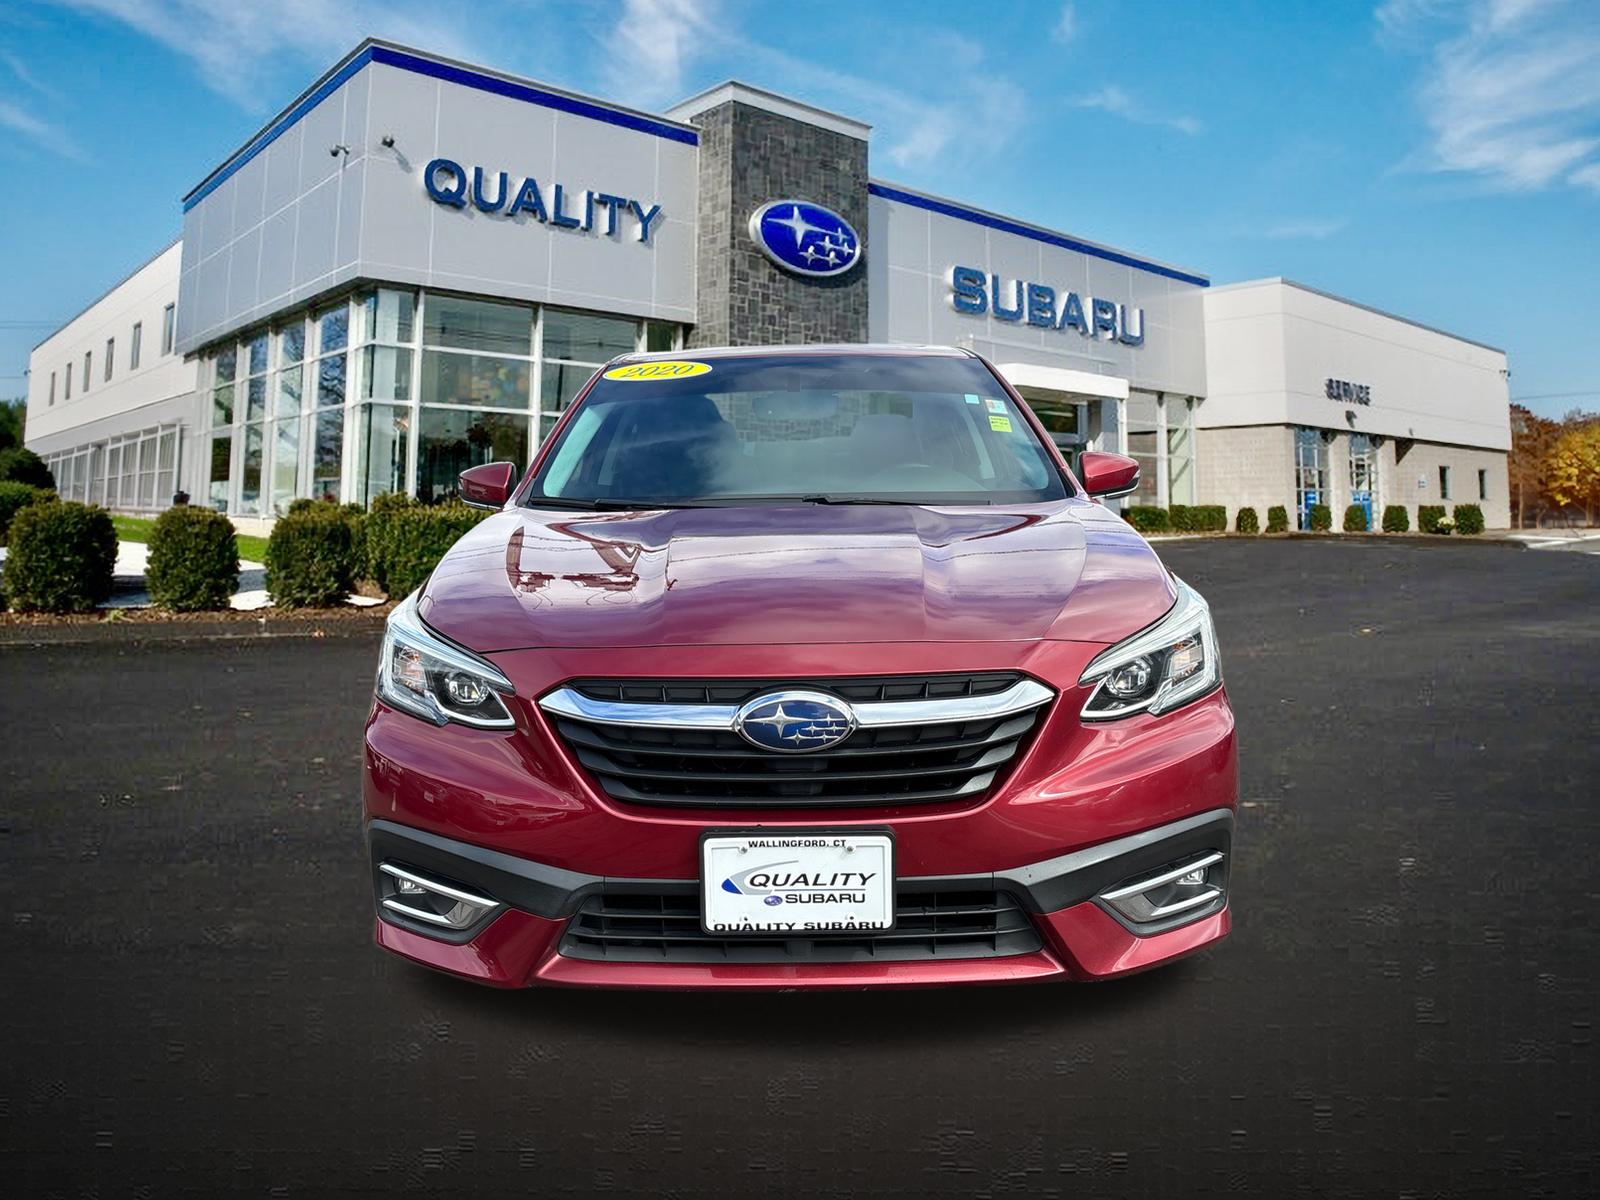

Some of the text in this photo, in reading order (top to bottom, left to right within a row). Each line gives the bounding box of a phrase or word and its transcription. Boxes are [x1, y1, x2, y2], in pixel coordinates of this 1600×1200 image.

[424, 158, 662, 243] QUALITY
[951, 265, 1145, 346] SUBARU
[622, 365, 694, 378] 2020
[833, 839, 846, 847] CT
[749, 873, 876, 886] QUALITY
[785, 893, 865, 904] SUBARU
[713, 921, 884, 931] QUALITY SUBARU
